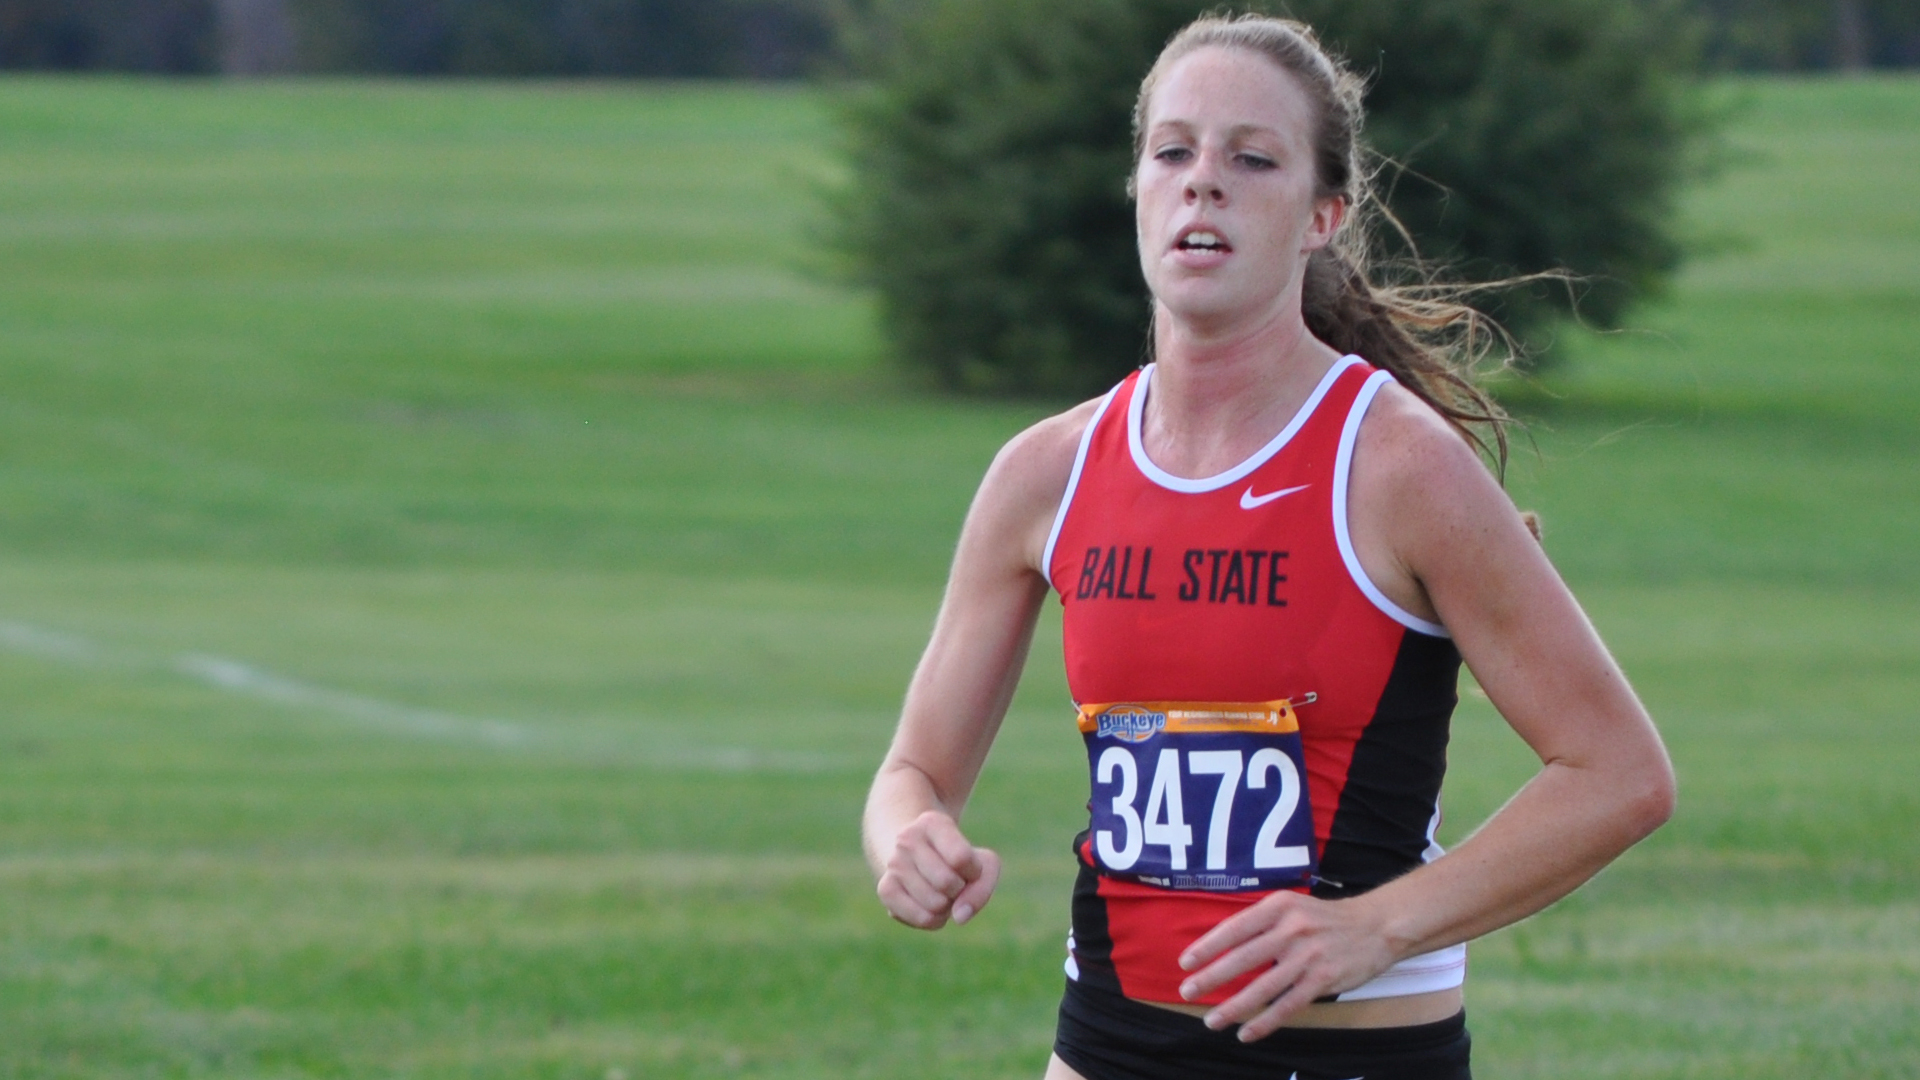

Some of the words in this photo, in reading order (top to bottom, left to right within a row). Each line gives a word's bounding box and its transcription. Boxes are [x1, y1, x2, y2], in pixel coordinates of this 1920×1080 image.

[1077, 546, 1156, 600] BALL
[1179, 549, 1289, 607] STATE
[1096, 711, 1166, 738] Buckeye
[1096, 746, 1310, 870] 3472
